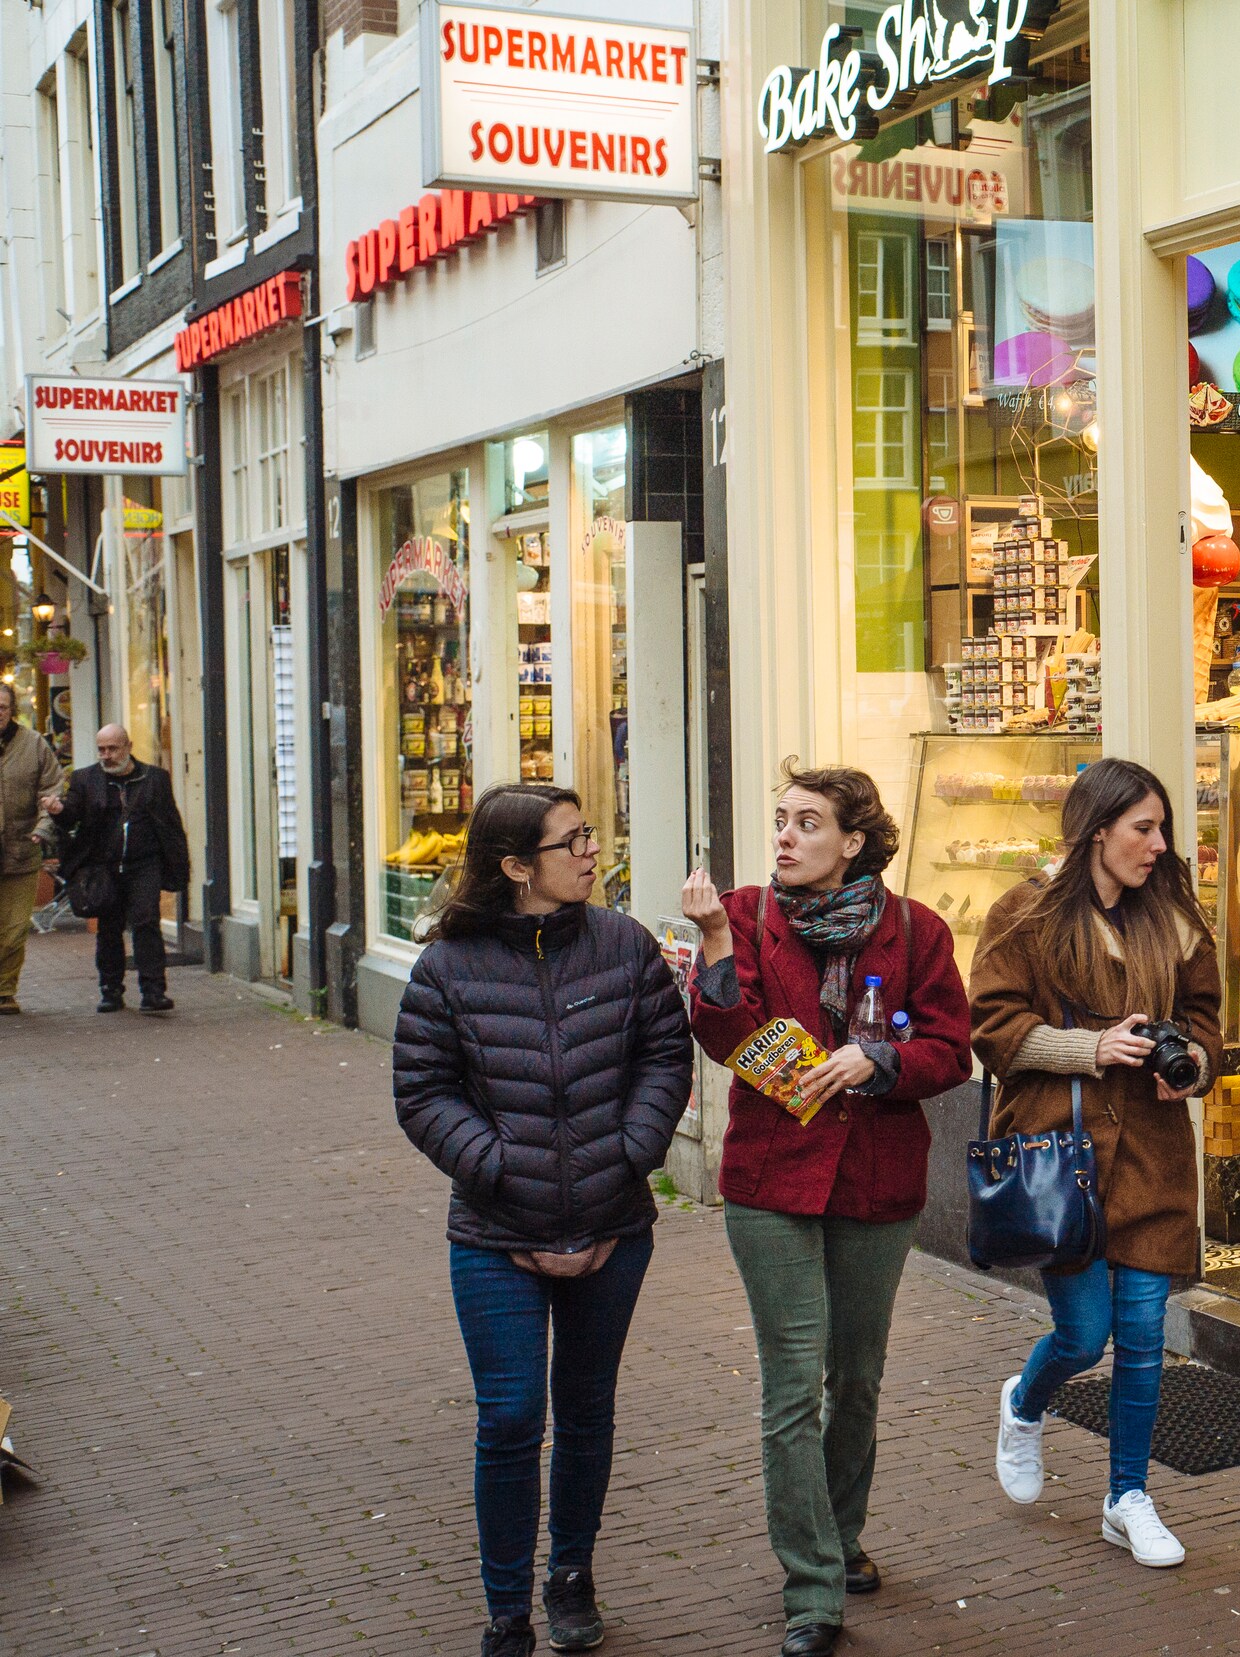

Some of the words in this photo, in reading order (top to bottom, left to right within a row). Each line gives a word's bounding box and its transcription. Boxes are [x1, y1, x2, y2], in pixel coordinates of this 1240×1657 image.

[441, 19, 688, 85] SUPERMARKET
[758, 23, 861, 153] Bake
[469, 120, 668, 177] SOUVENIRS
[174, 271, 288, 373] SUPERMARKET
[35, 385, 178, 413] SUPERMARKET
[998, 391, 1032, 412] Waffle
[55, 437, 163, 464] SOUVENIRS
[0, 491, 20, 508] SE
[328, 496, 340, 539] 12
[581, 515, 625, 556] SOUVENIR
[378, 534, 468, 623] SUPERMARKET
[737, 1020, 788, 1070] HARIBO
[752, 1035, 796, 1076] Goudberen
